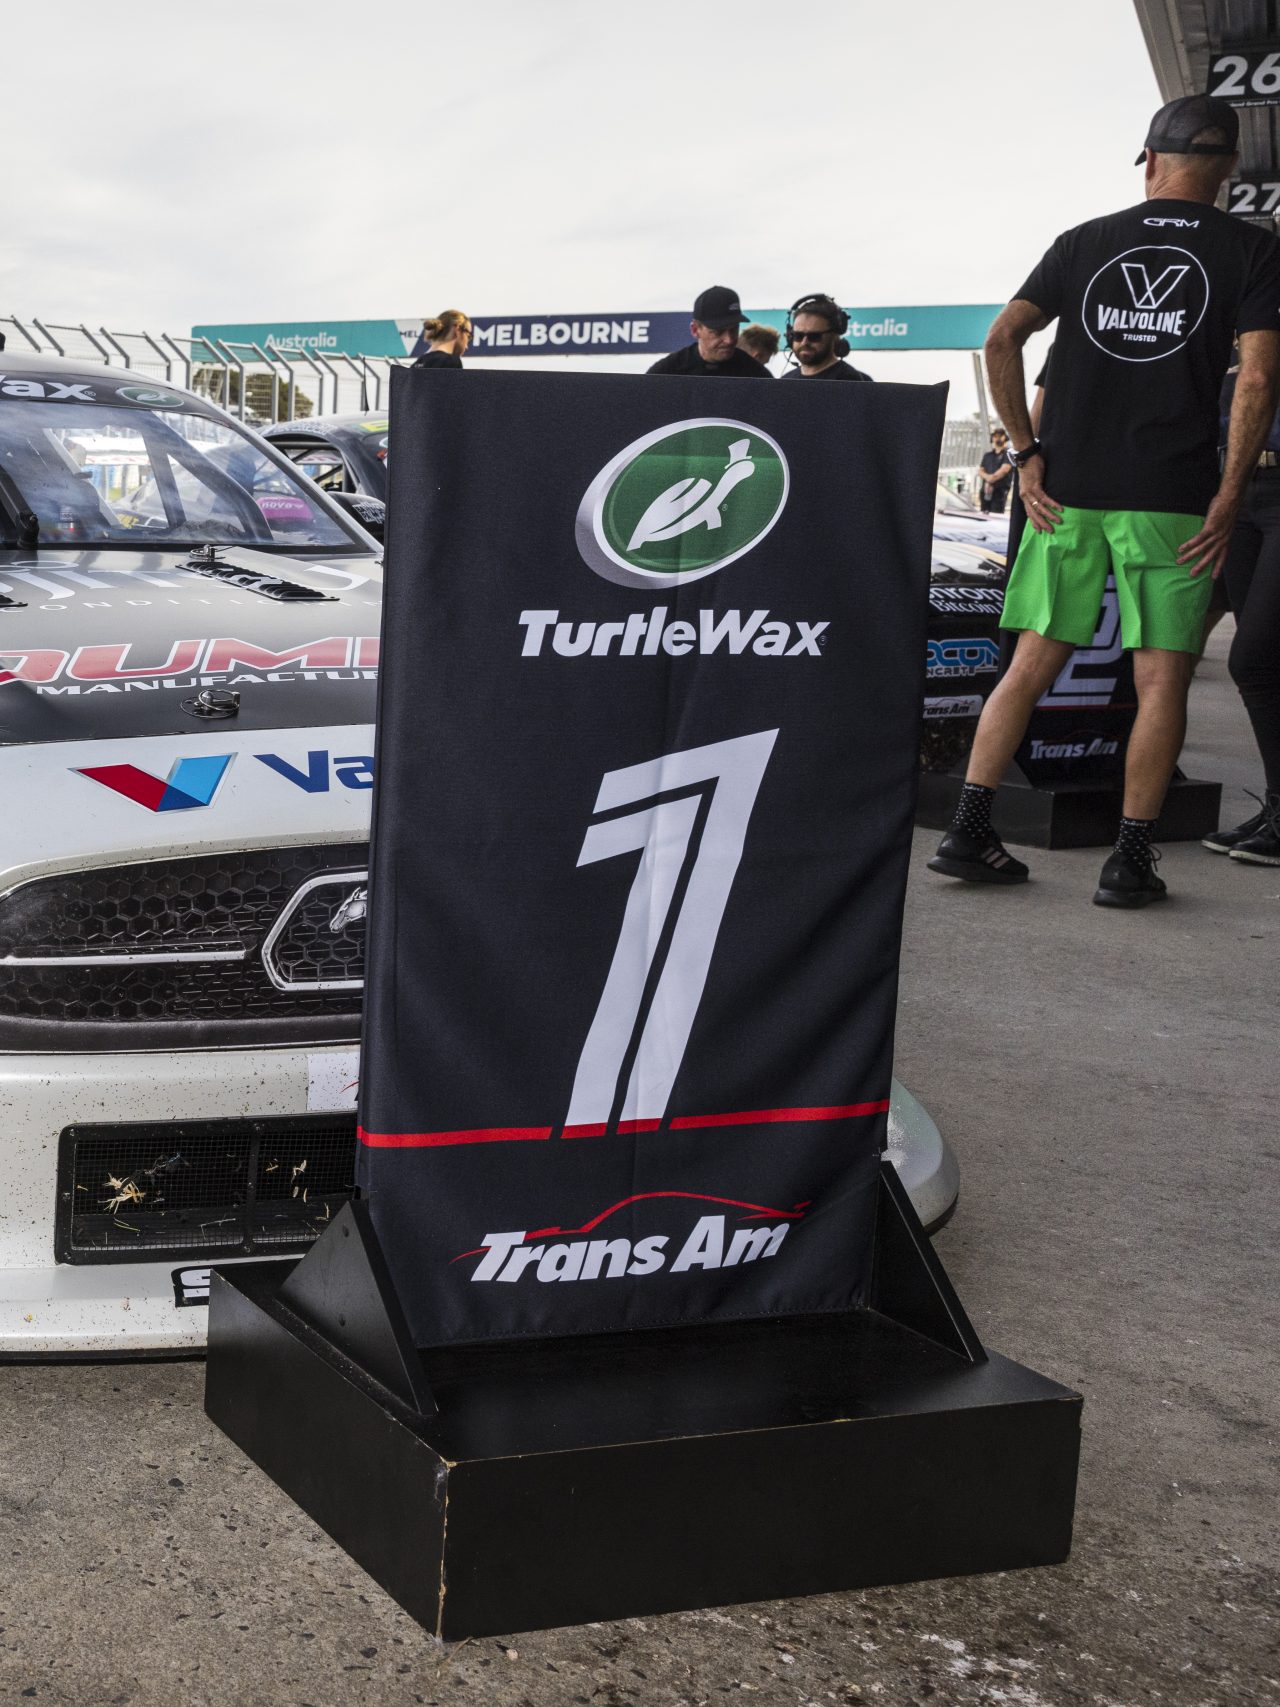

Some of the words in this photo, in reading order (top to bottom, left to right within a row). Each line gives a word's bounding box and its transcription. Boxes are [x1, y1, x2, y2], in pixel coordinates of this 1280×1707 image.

[1210, 53, 1280, 97] 26
[1143, 218, 1200, 228] GRM
[843, 319, 908, 338] stralia
[1098, 304, 1186, 336] VALVOLINE
[263, 332, 337, 350] Australia
[473, 320, 650, 347] MELBOURNE
[1123, 334, 1157, 343] TRUSTED
[518, 606, 831, 657] TurtleWax
[36, 670, 380, 696] MANUFACTUR
[1030, 740, 1086, 760] Trans
[1085, 738, 1118, 757] Am
[471, 1231, 670, 1282] Trans
[669, 1214, 790, 1273] Am
